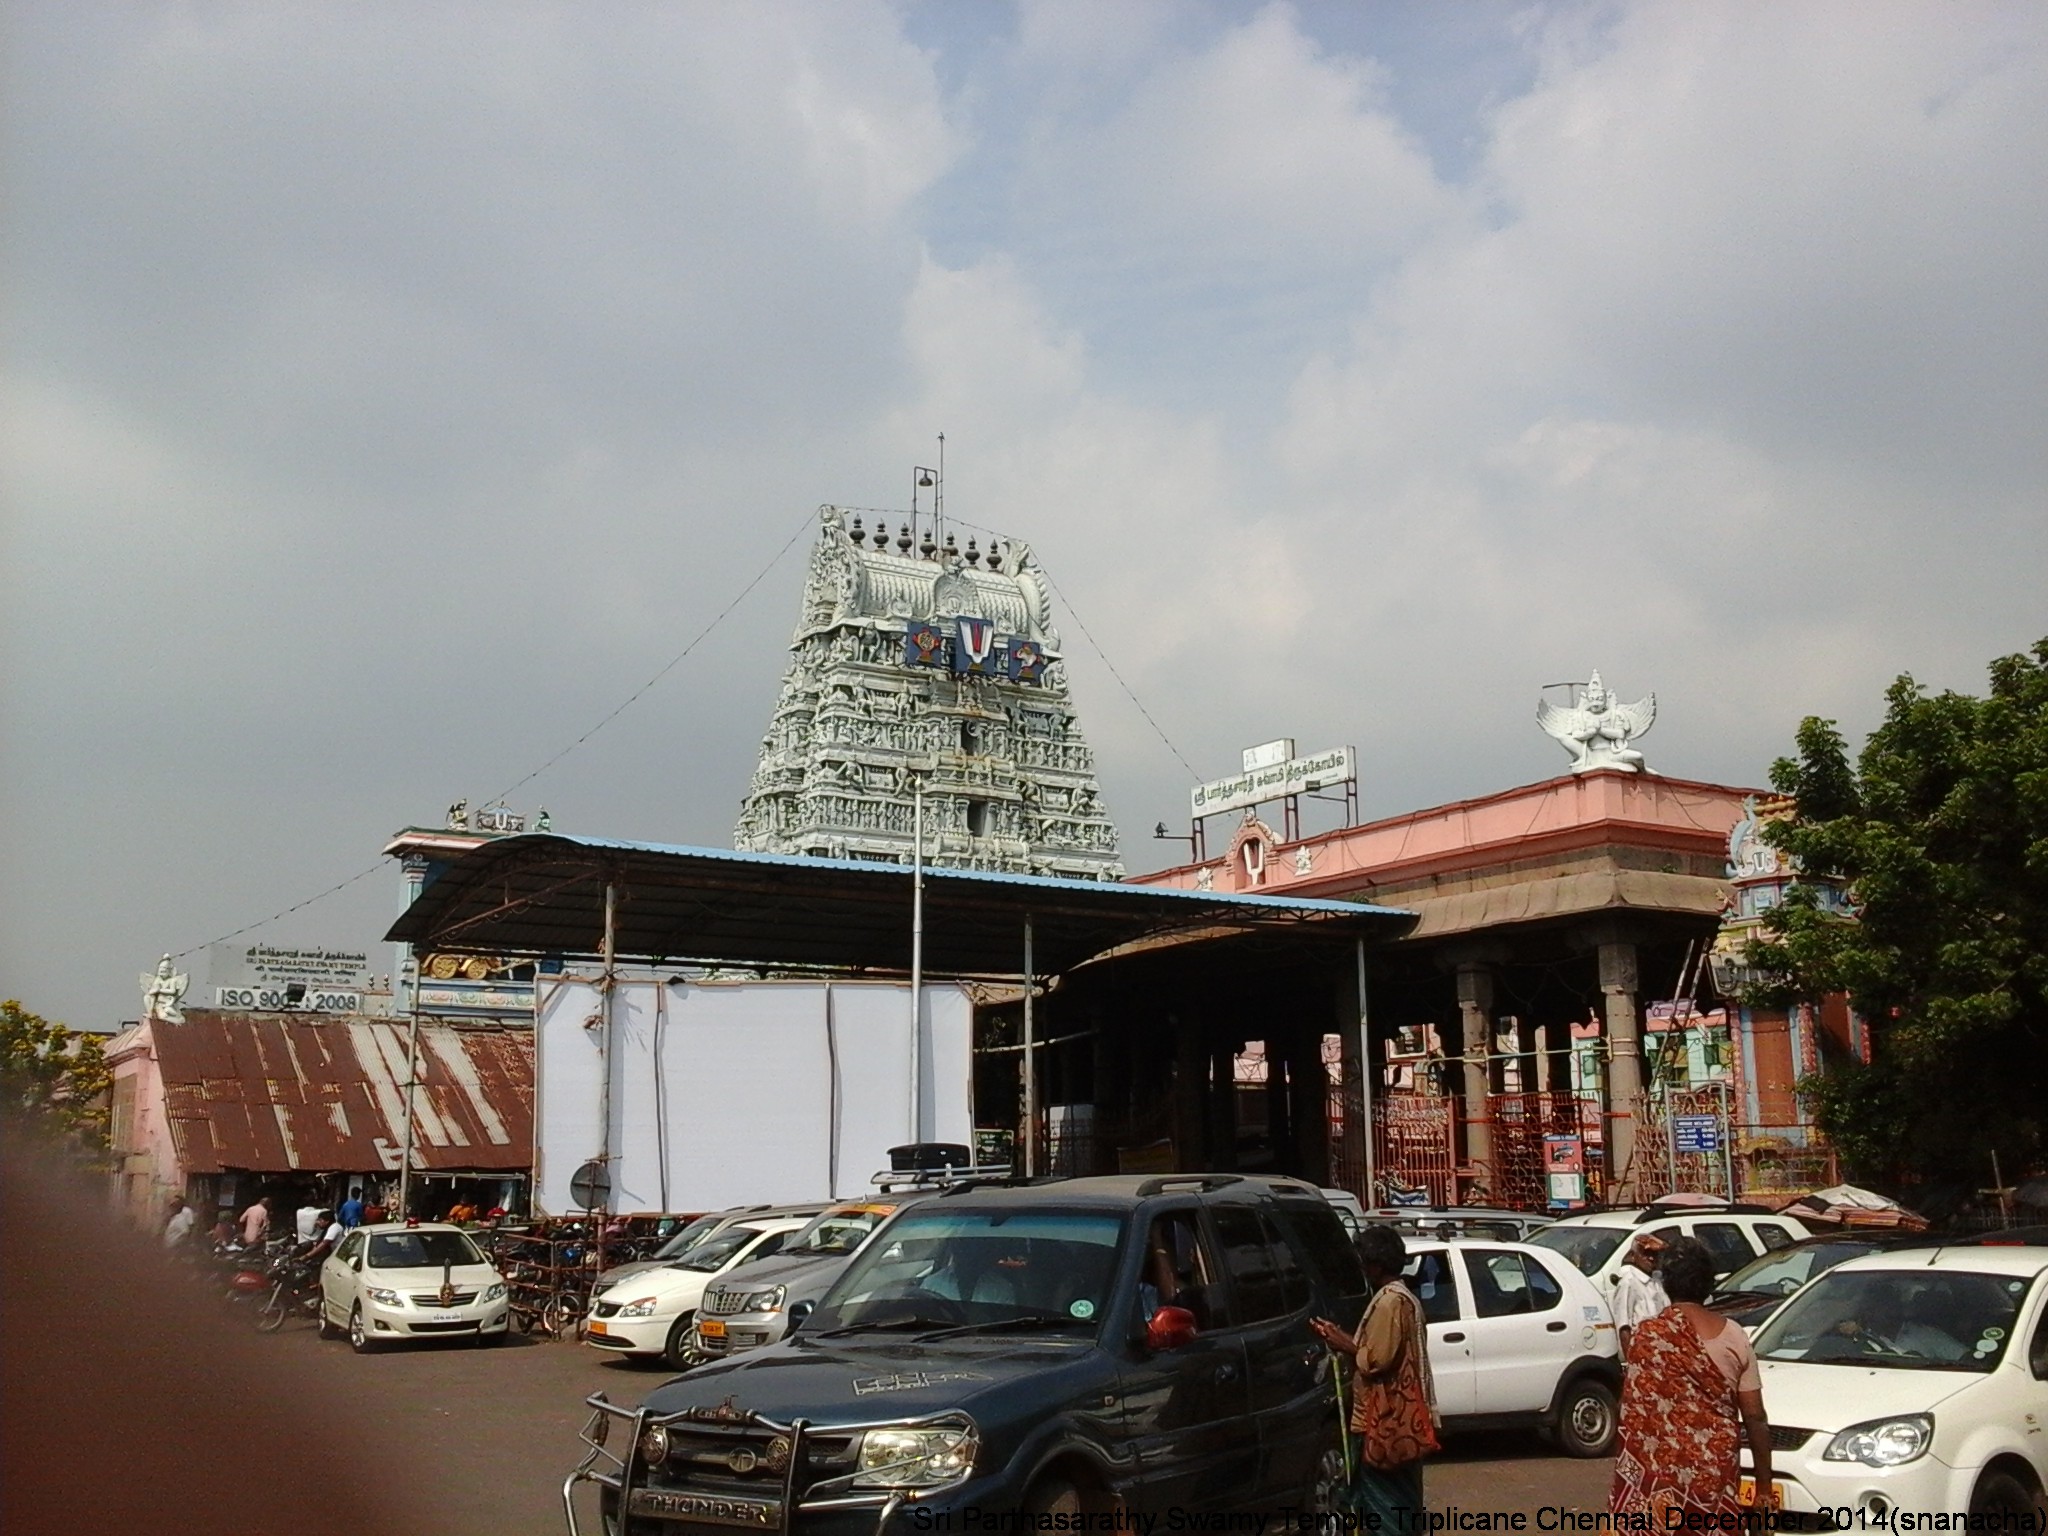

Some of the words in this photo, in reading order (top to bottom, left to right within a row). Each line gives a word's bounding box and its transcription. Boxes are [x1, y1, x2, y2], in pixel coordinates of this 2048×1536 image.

[1194, 786, 1206, 806] ஸ்ரீ
[221, 989, 254, 1007] ISO
[259, 990, 297, 1008] 900
[315, 993, 357, 1010] 2008
[646, 1493, 768, 1524] THUNDER
